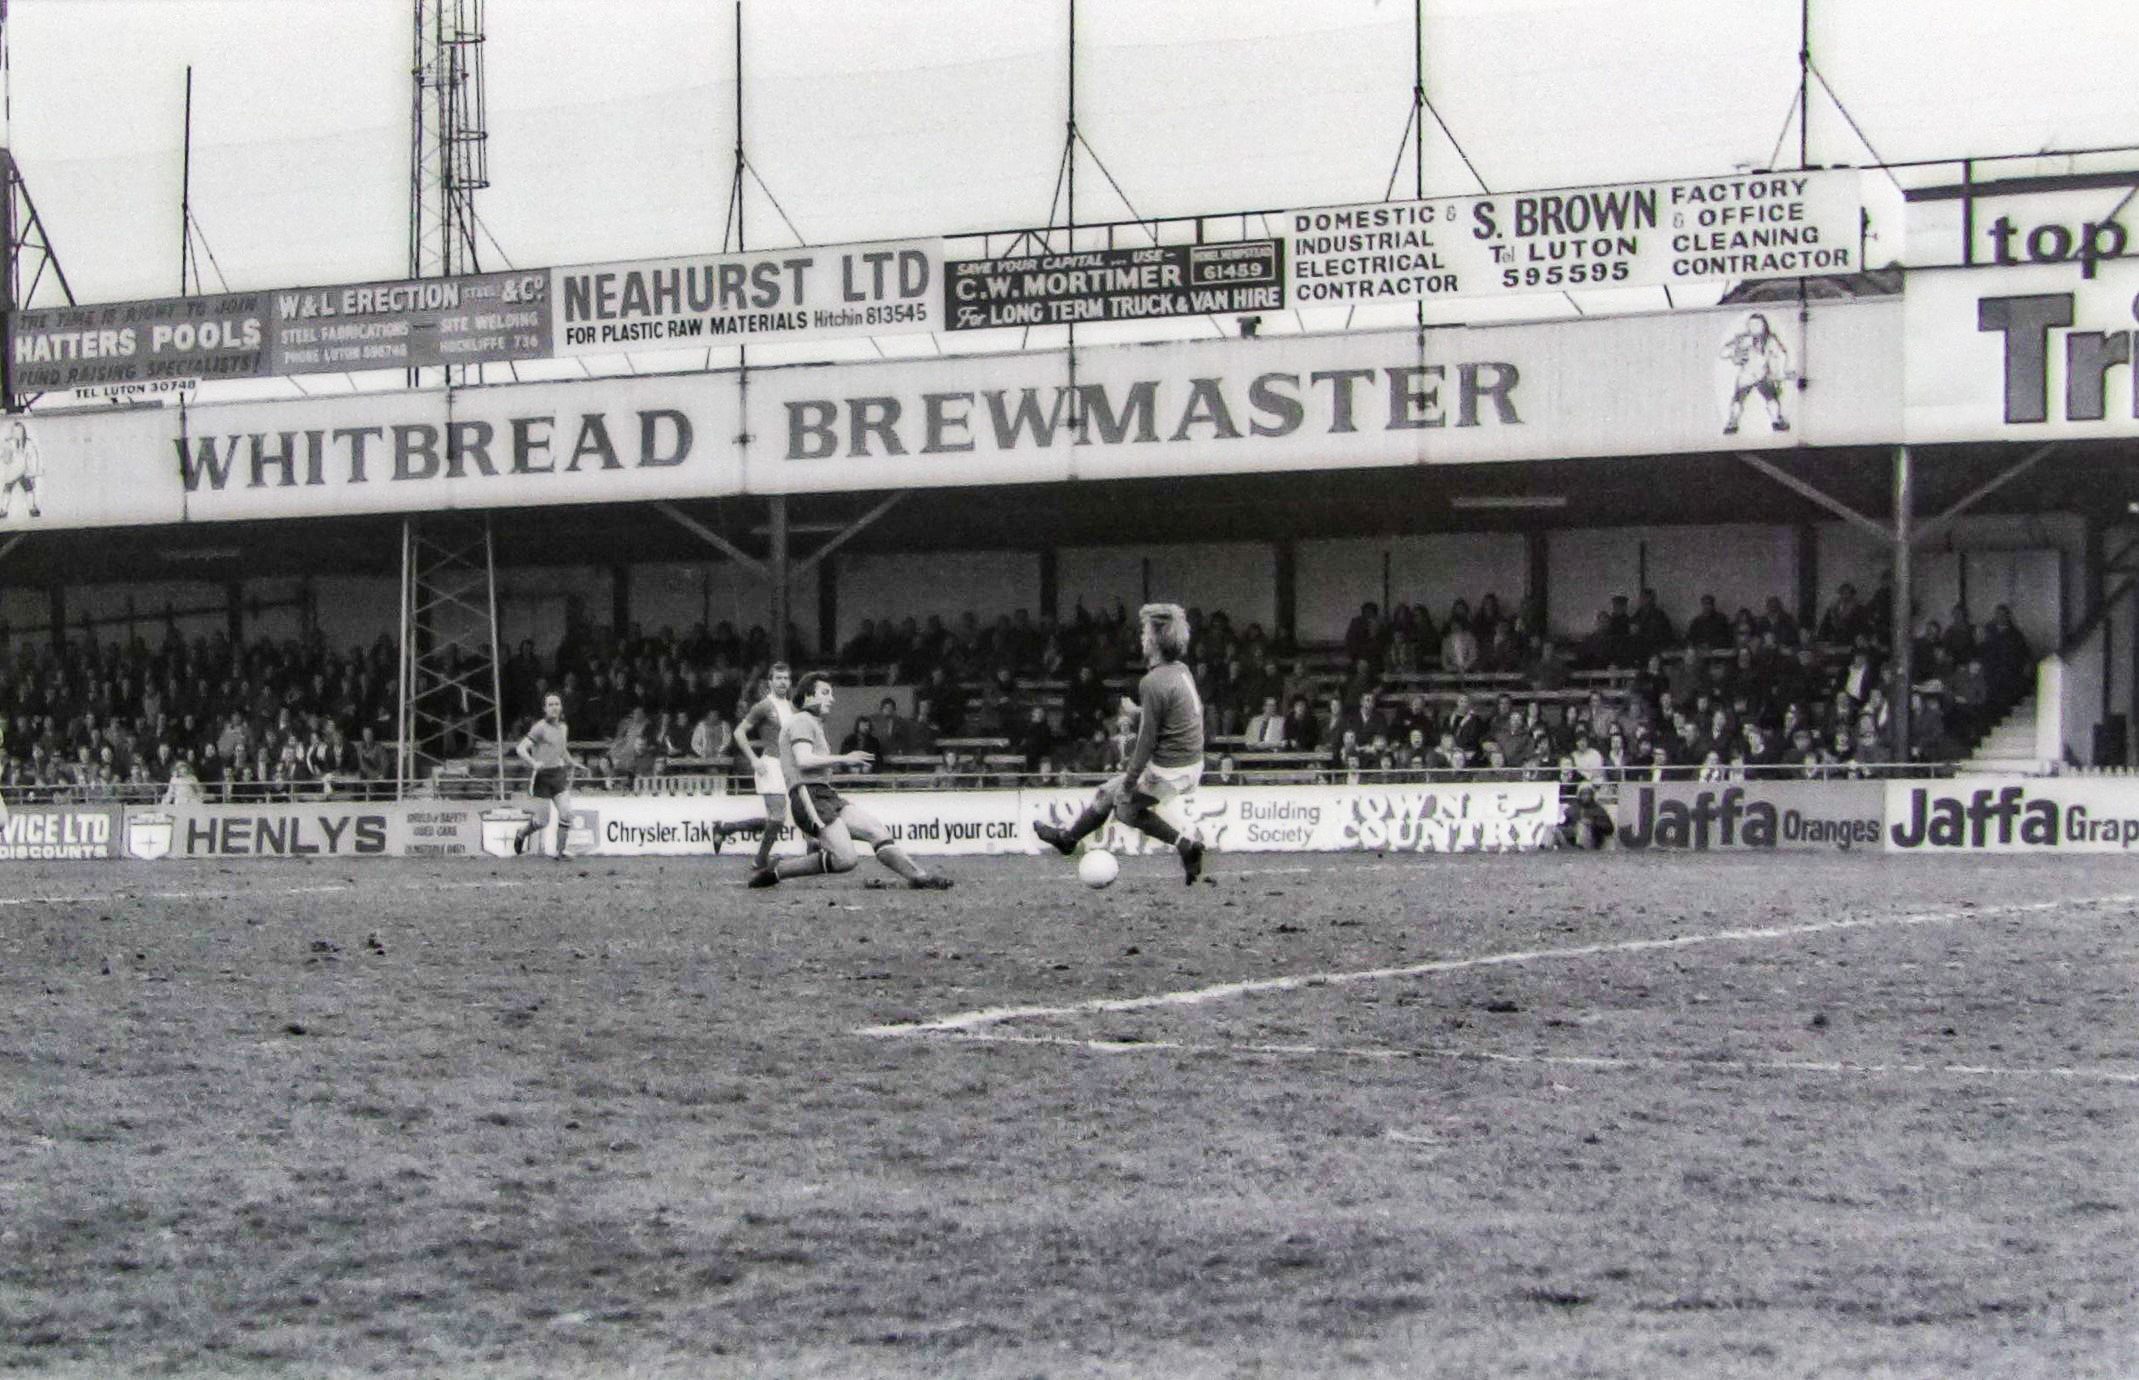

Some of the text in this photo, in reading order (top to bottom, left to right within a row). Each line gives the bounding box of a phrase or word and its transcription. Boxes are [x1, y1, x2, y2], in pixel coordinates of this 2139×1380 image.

[1671, 178, 1808, 205] FACTORY
[1295, 206, 1435, 232] DOMESTIC
[1472, 188, 1657, 240] S. BROWN
[1699, 202, 1804, 227] OFFICE
[1295, 230, 1434, 256] INDUSTRIAL
[1489, 235, 1638, 264] Tel LUTON
[1672, 225, 1820, 252] CLEANING
[1987, 216, 2128, 279] top
[956, 261, 993, 276] SAVE
[997, 258, 1037, 273] YOUR
[1042, 254, 1105, 270] CAPITAL
[1203, 262, 1263, 280] 61459
[1295, 252, 1445, 278] ELECTRICAL
[1502, 261, 1630, 288] 595595
[1673, 248, 1849, 277] CONTRACTOR
[343, 283, 461, 315] ERECTION
[564, 249, 930, 322] NEAHURST LTD
[1296, 274, 1459, 301] CONTRACTOR
[956, 286, 1280, 329] For LONG TERM TRUCK & VAN HIRE
[440, 311, 538, 333] SITE WELDING
[567, 303, 927, 345] FOR PLASTIC RAW MATERIALS Hitchin 813545
[15, 318, 262, 364] HATTERS POOLS
[1978, 290, 2139, 424] Tr
[67, 364, 136, 383] RAISING
[75, 388, 96, 399] TEL
[104, 384, 145, 397] LUTON
[173, 362, 1525, 492] WHITBREAD BREWMASTER
[1241, 801, 1320, 825] Building
[1619, 787, 1880, 850] Jaffa Oranges
[1891, 787, 2139, 849] Jaffa Grap
[64, 813, 111, 844] LTD
[187, 815, 387, 854] HENLYS
[908, 818, 939, 840] and
[945, 823, 981, 844] your
[986, 822, 1018, 840] car.
[1247, 824, 1314, 847] Society
[1339, 818, 1547, 853] COUNTRY
